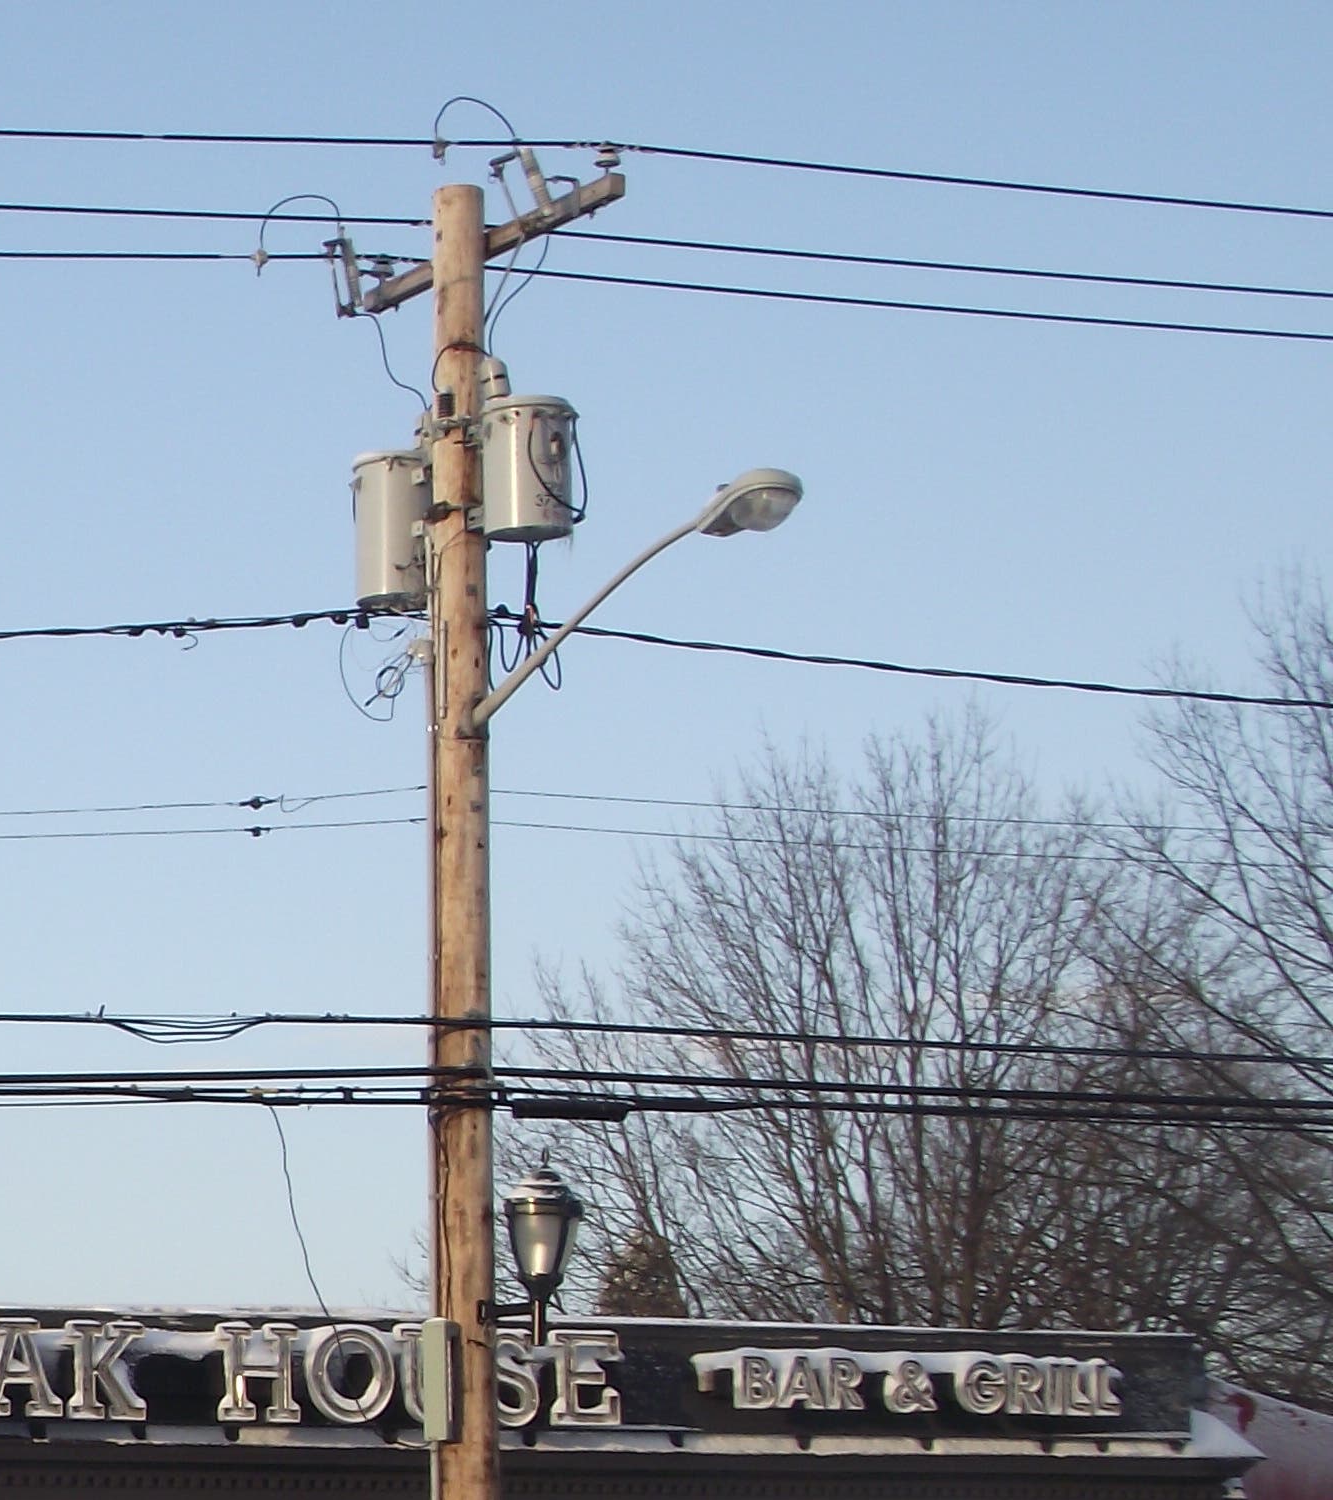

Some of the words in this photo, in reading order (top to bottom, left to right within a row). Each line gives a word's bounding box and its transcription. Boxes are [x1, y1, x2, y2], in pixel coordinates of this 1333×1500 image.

[735, 1349, 865, 1410] BAR
[887, 1357, 939, 1414] &
[959, 1356, 1121, 1416] GRILL
